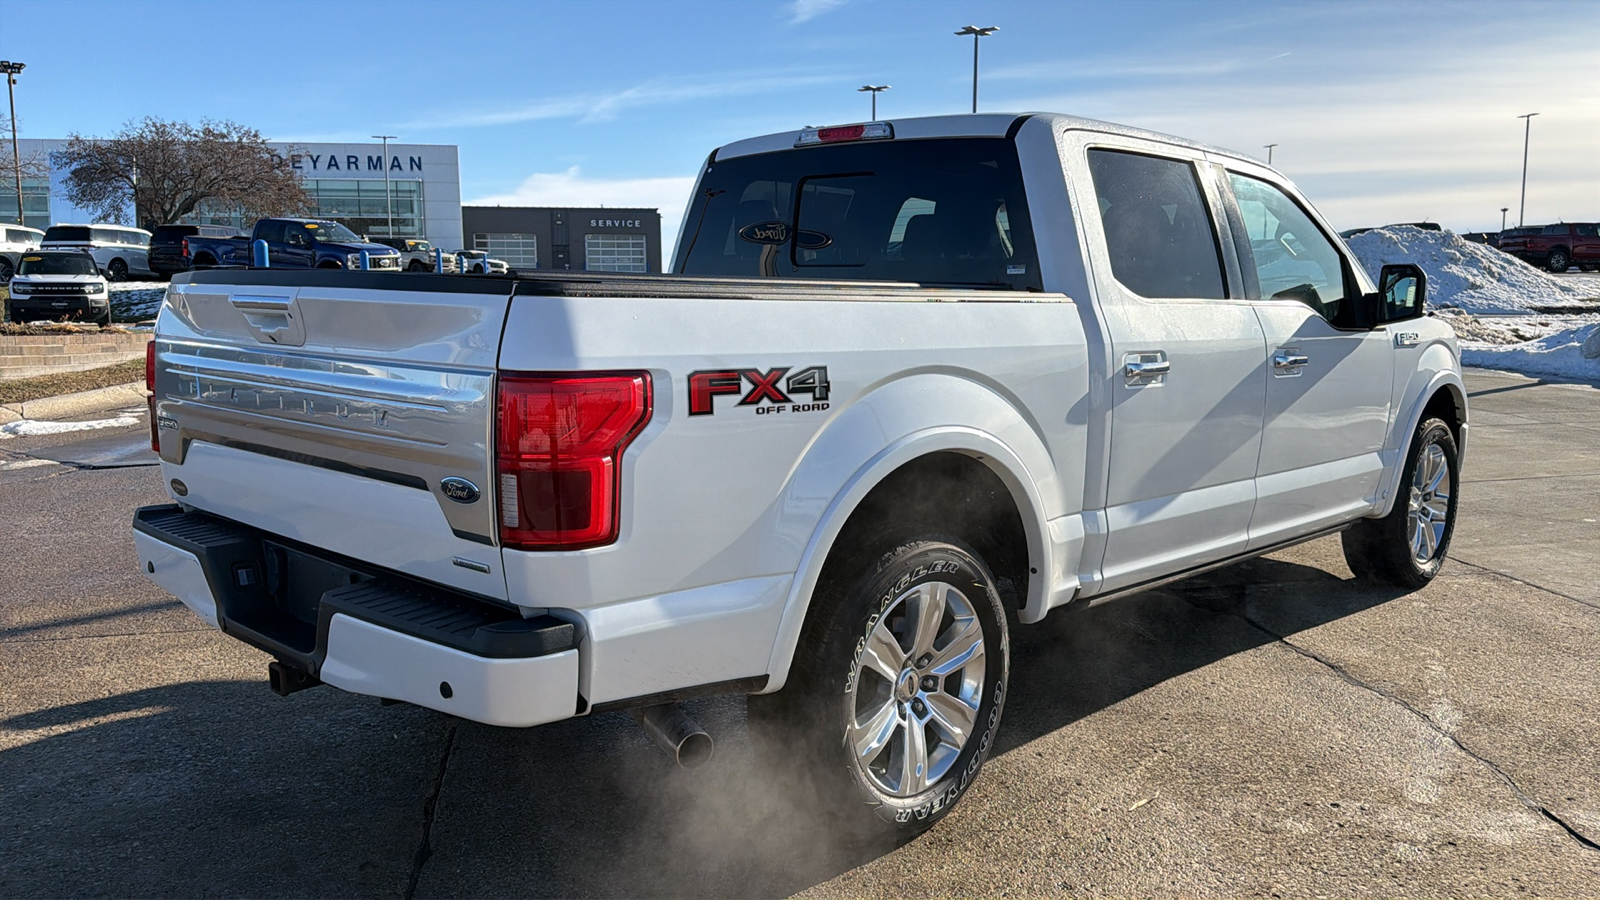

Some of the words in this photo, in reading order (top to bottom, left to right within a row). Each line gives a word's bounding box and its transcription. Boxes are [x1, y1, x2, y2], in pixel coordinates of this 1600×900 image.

[270, 154, 423, 171] DEYARMAN
[590, 219, 641, 228] SERVICE
[687, 365, 831, 418] FX4
[756, 405, 786, 415] OFF
[791, 402, 830, 413] ROAD
[446, 481, 469, 499] Ford
[845, 560, 960, 693] WRANGLER
[895, 680, 1002, 823] GOODYEAR
